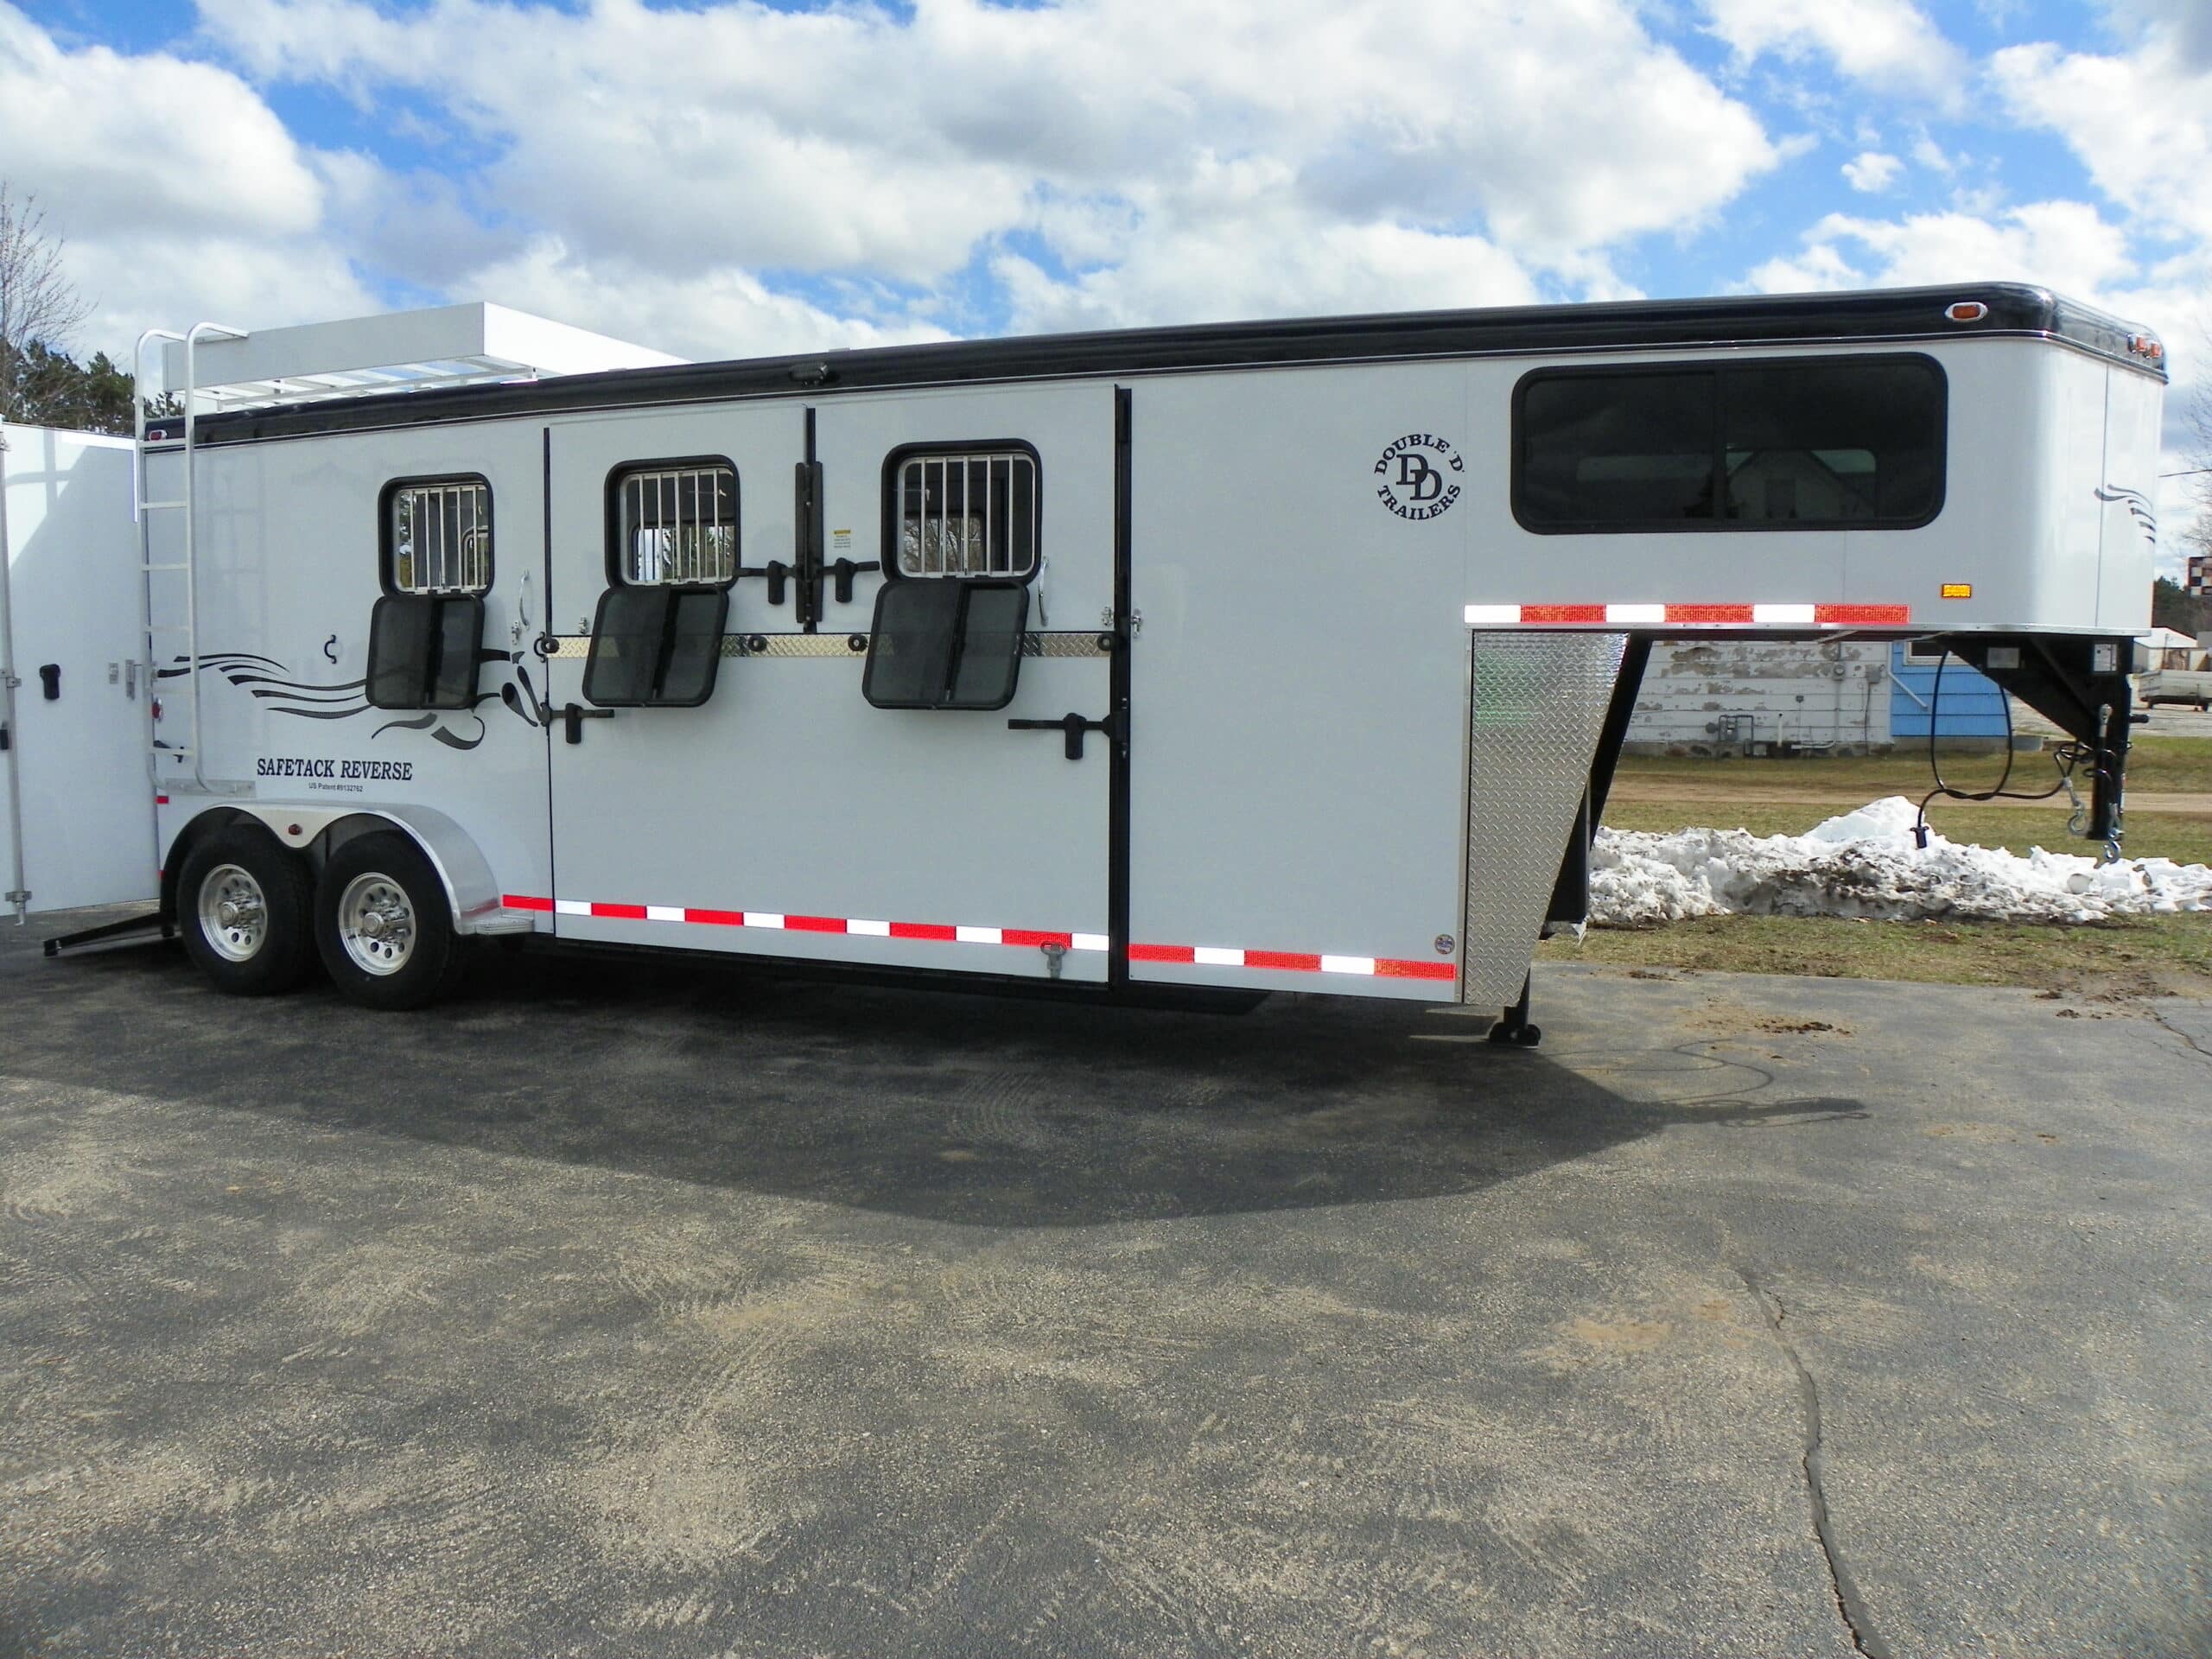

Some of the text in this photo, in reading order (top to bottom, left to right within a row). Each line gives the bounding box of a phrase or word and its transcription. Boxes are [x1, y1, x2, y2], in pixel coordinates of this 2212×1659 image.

[1375, 434, 1450, 475] DOUBLE
[1377, 485, 1461, 520] TRAILERS
[257, 758, 413, 780] SAFETACK REVERSE
[318, 782, 336, 791] Patent
